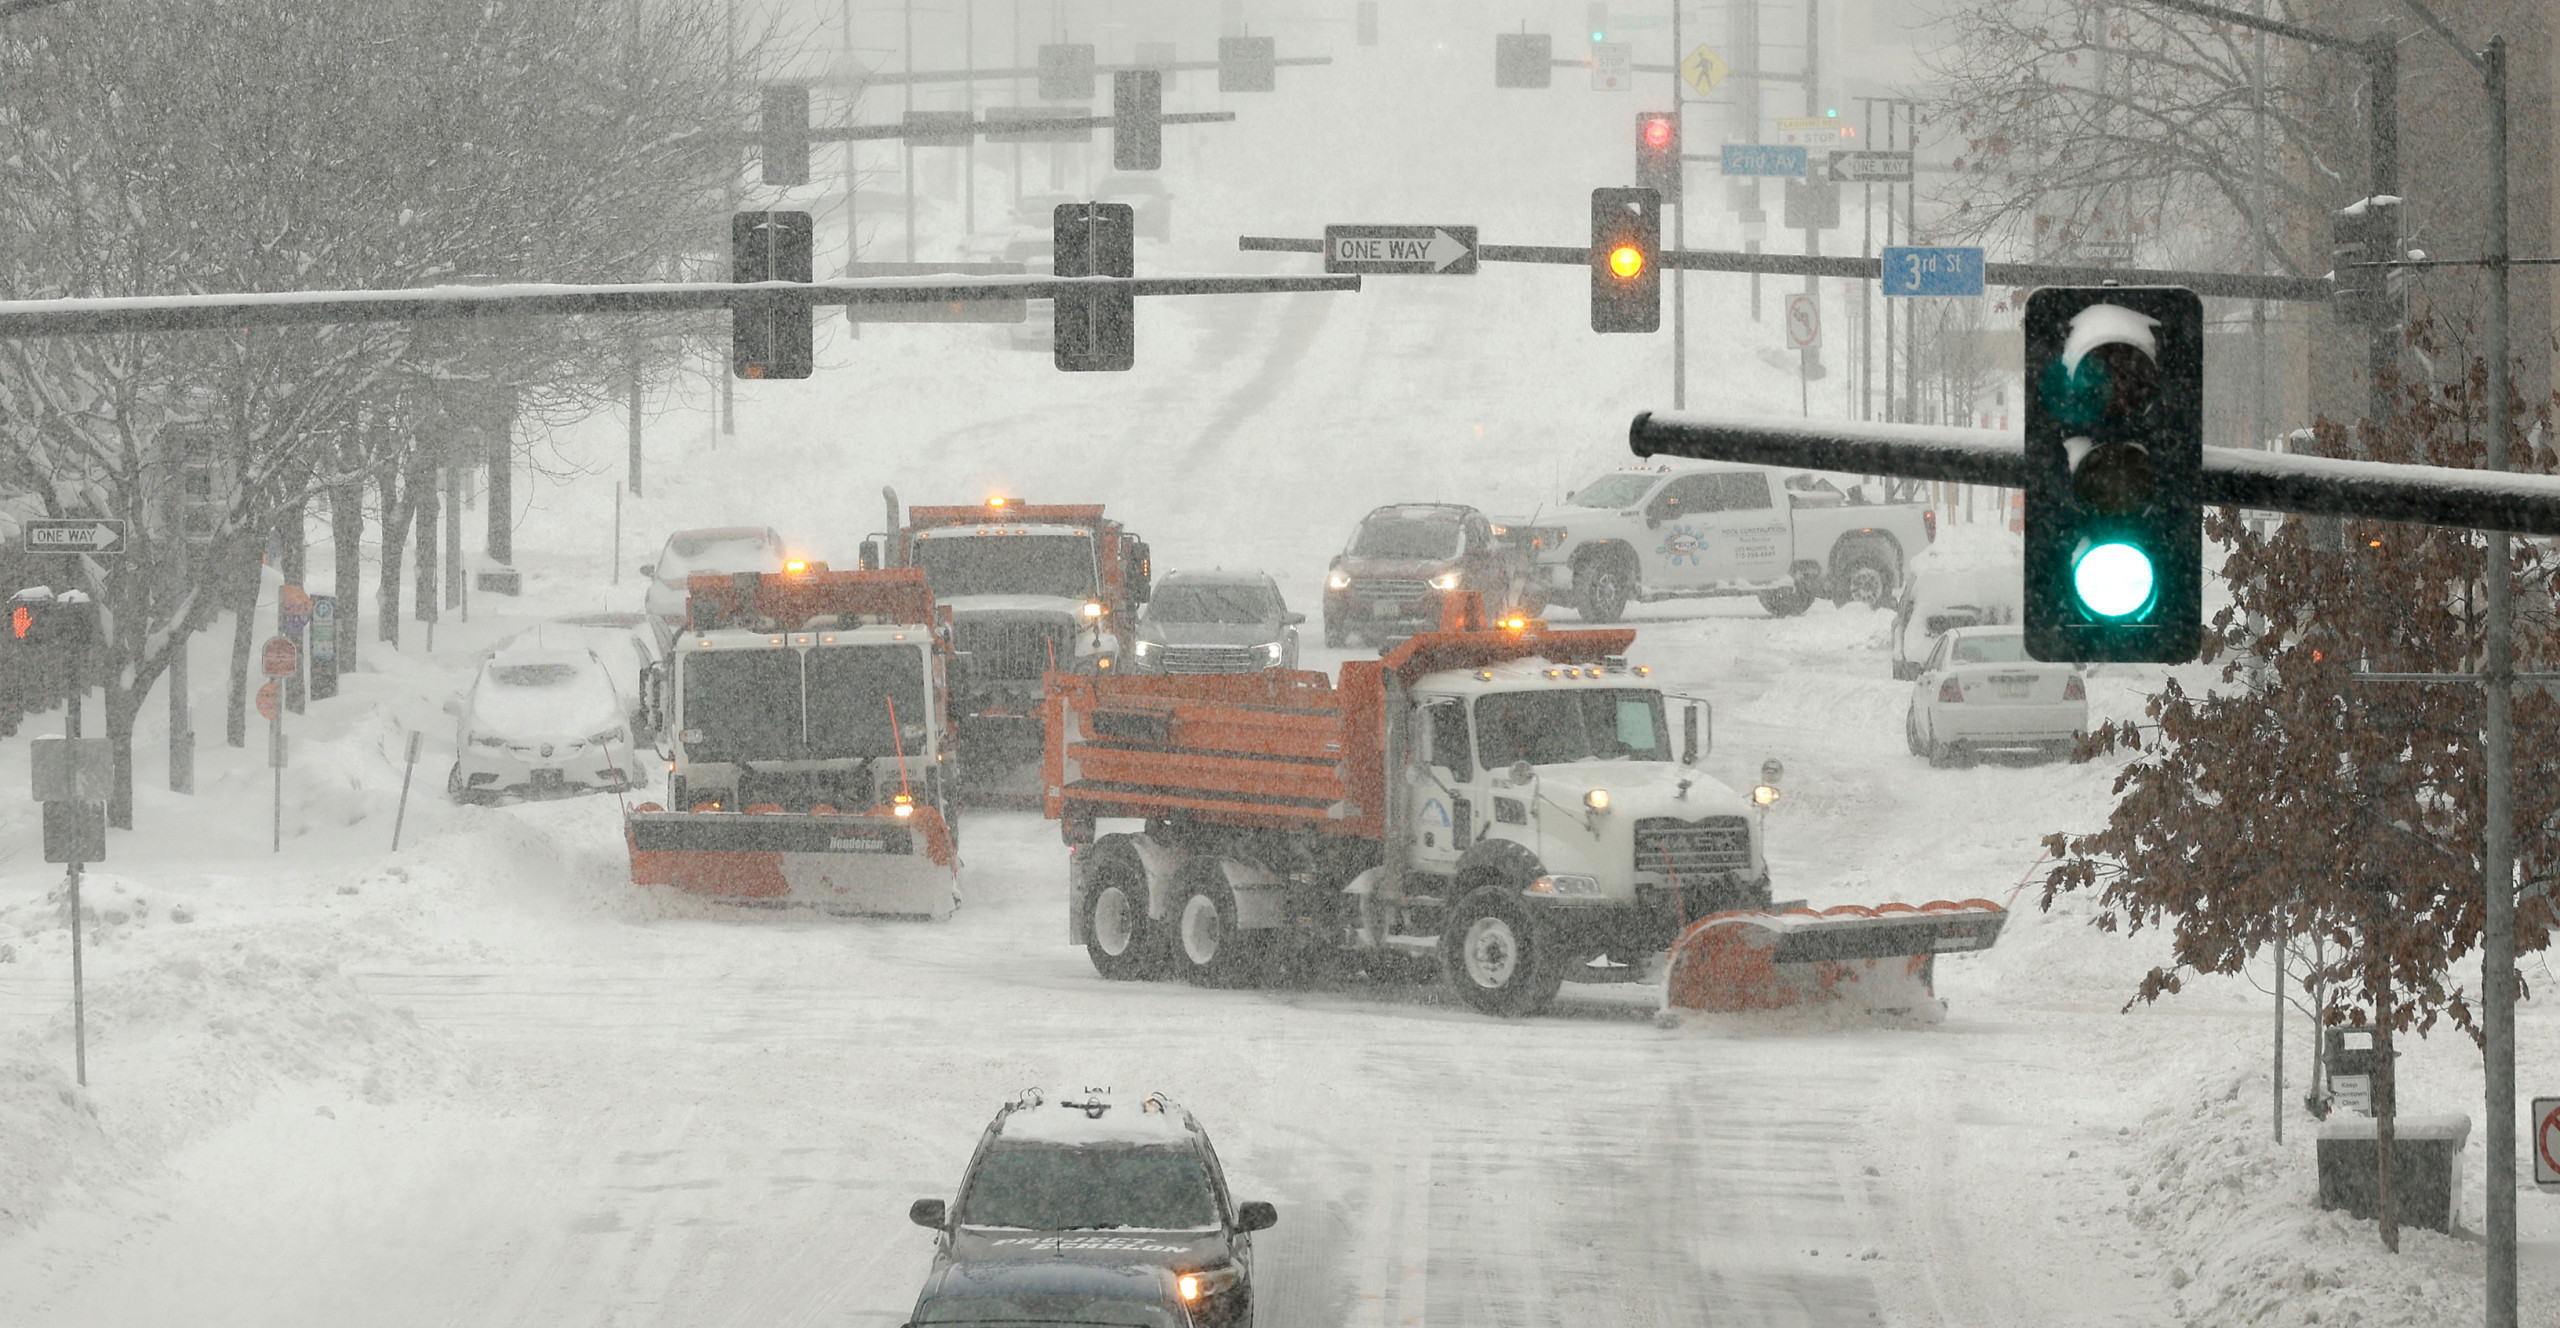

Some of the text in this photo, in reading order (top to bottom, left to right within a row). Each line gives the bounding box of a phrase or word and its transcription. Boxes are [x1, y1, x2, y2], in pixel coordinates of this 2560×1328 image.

[1804, 133, 1835, 143] STOP
[1732, 152, 1797, 168] 2nd Av
[1853, 161, 1905, 173] ONE WAY
[1341, 240, 1431, 259] ONE WAY
[1905, 252, 1961, 290] 3rd St
[37, 530, 96, 542] ONE WAY
[1673, 541, 1697, 549] PECK
[829, 836, 885, 849] Henderson
[991, 1237, 1158, 1246] PROJECT
[1030, 1243, 1193, 1254] ECHELON
